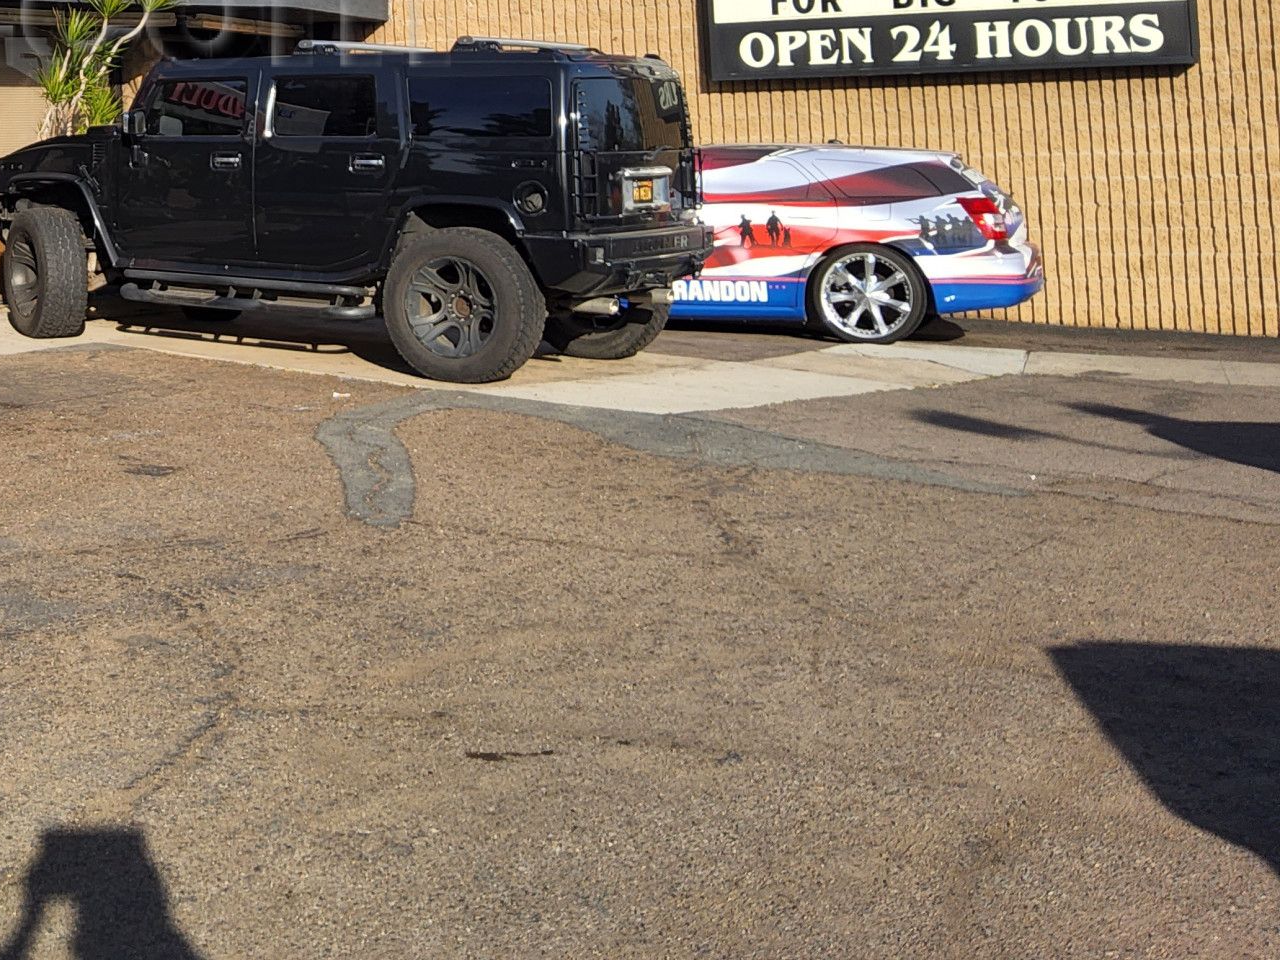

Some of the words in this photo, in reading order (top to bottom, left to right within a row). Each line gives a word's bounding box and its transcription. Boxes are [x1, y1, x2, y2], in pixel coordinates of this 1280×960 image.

[739, 27, 875, 68] OPEN
[890, 19, 957, 61] 24
[973, 13, 1165, 58] HOURS
[672, 279, 769, 302] RANDON
